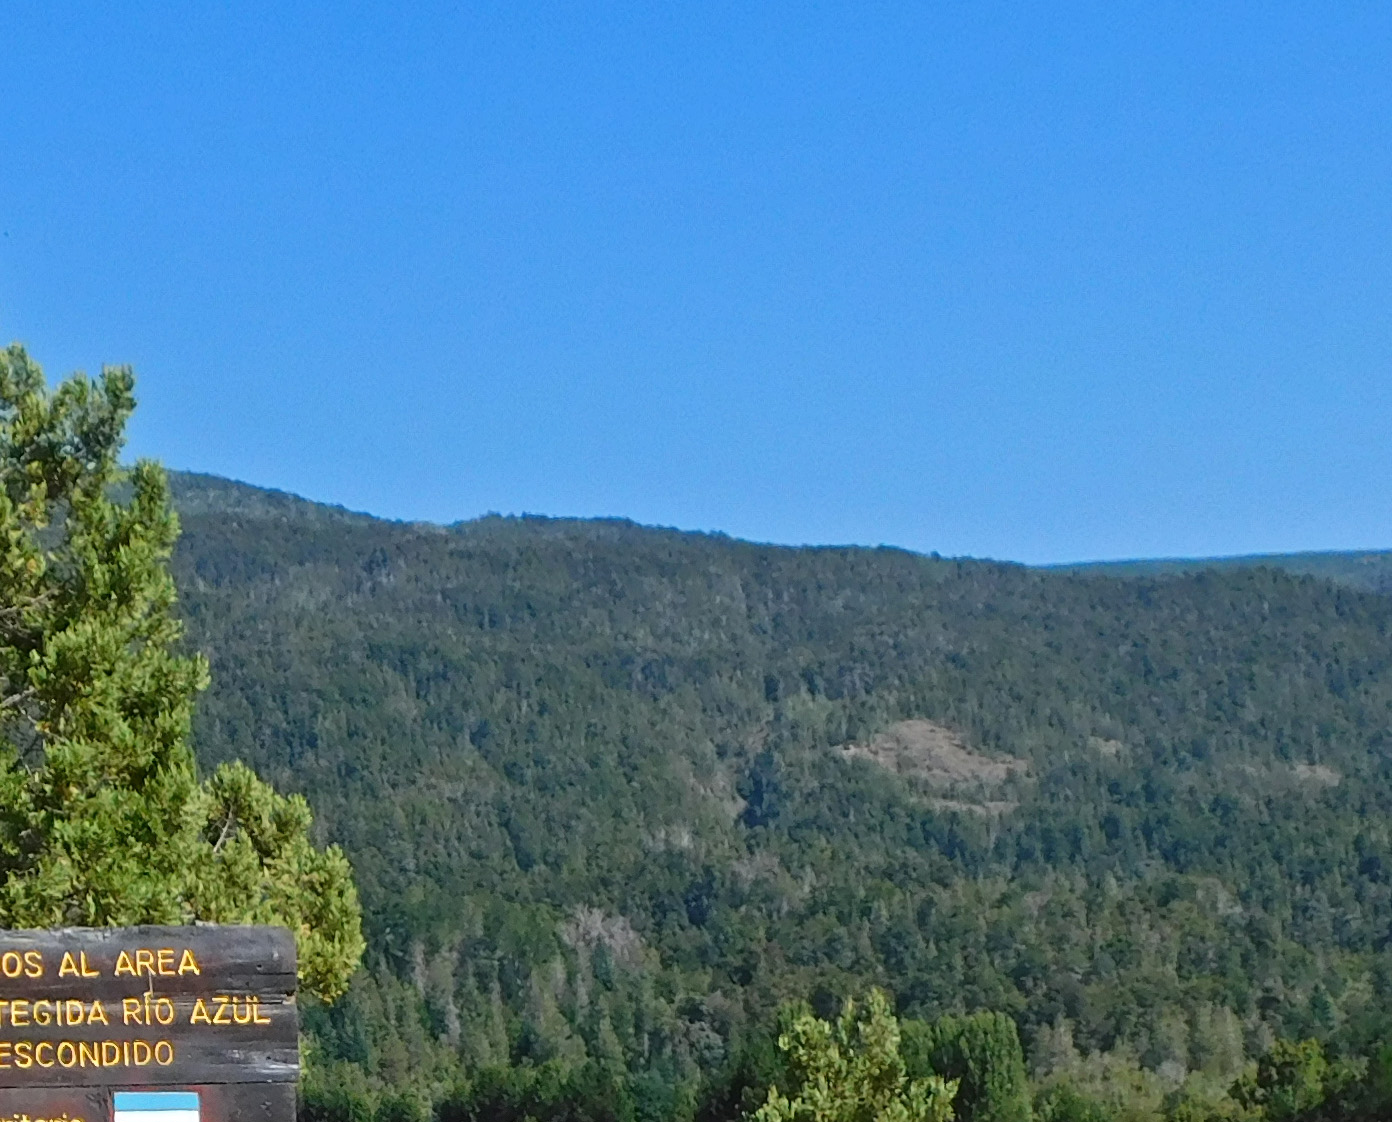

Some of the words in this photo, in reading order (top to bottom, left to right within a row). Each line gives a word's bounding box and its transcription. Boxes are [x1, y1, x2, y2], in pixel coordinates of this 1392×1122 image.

[58, 951, 100, 978] AL
[115, 950, 200, 976] AREA
[123, 993, 174, 1025] RÍO
[190, 997, 271, 1024] AZUL
